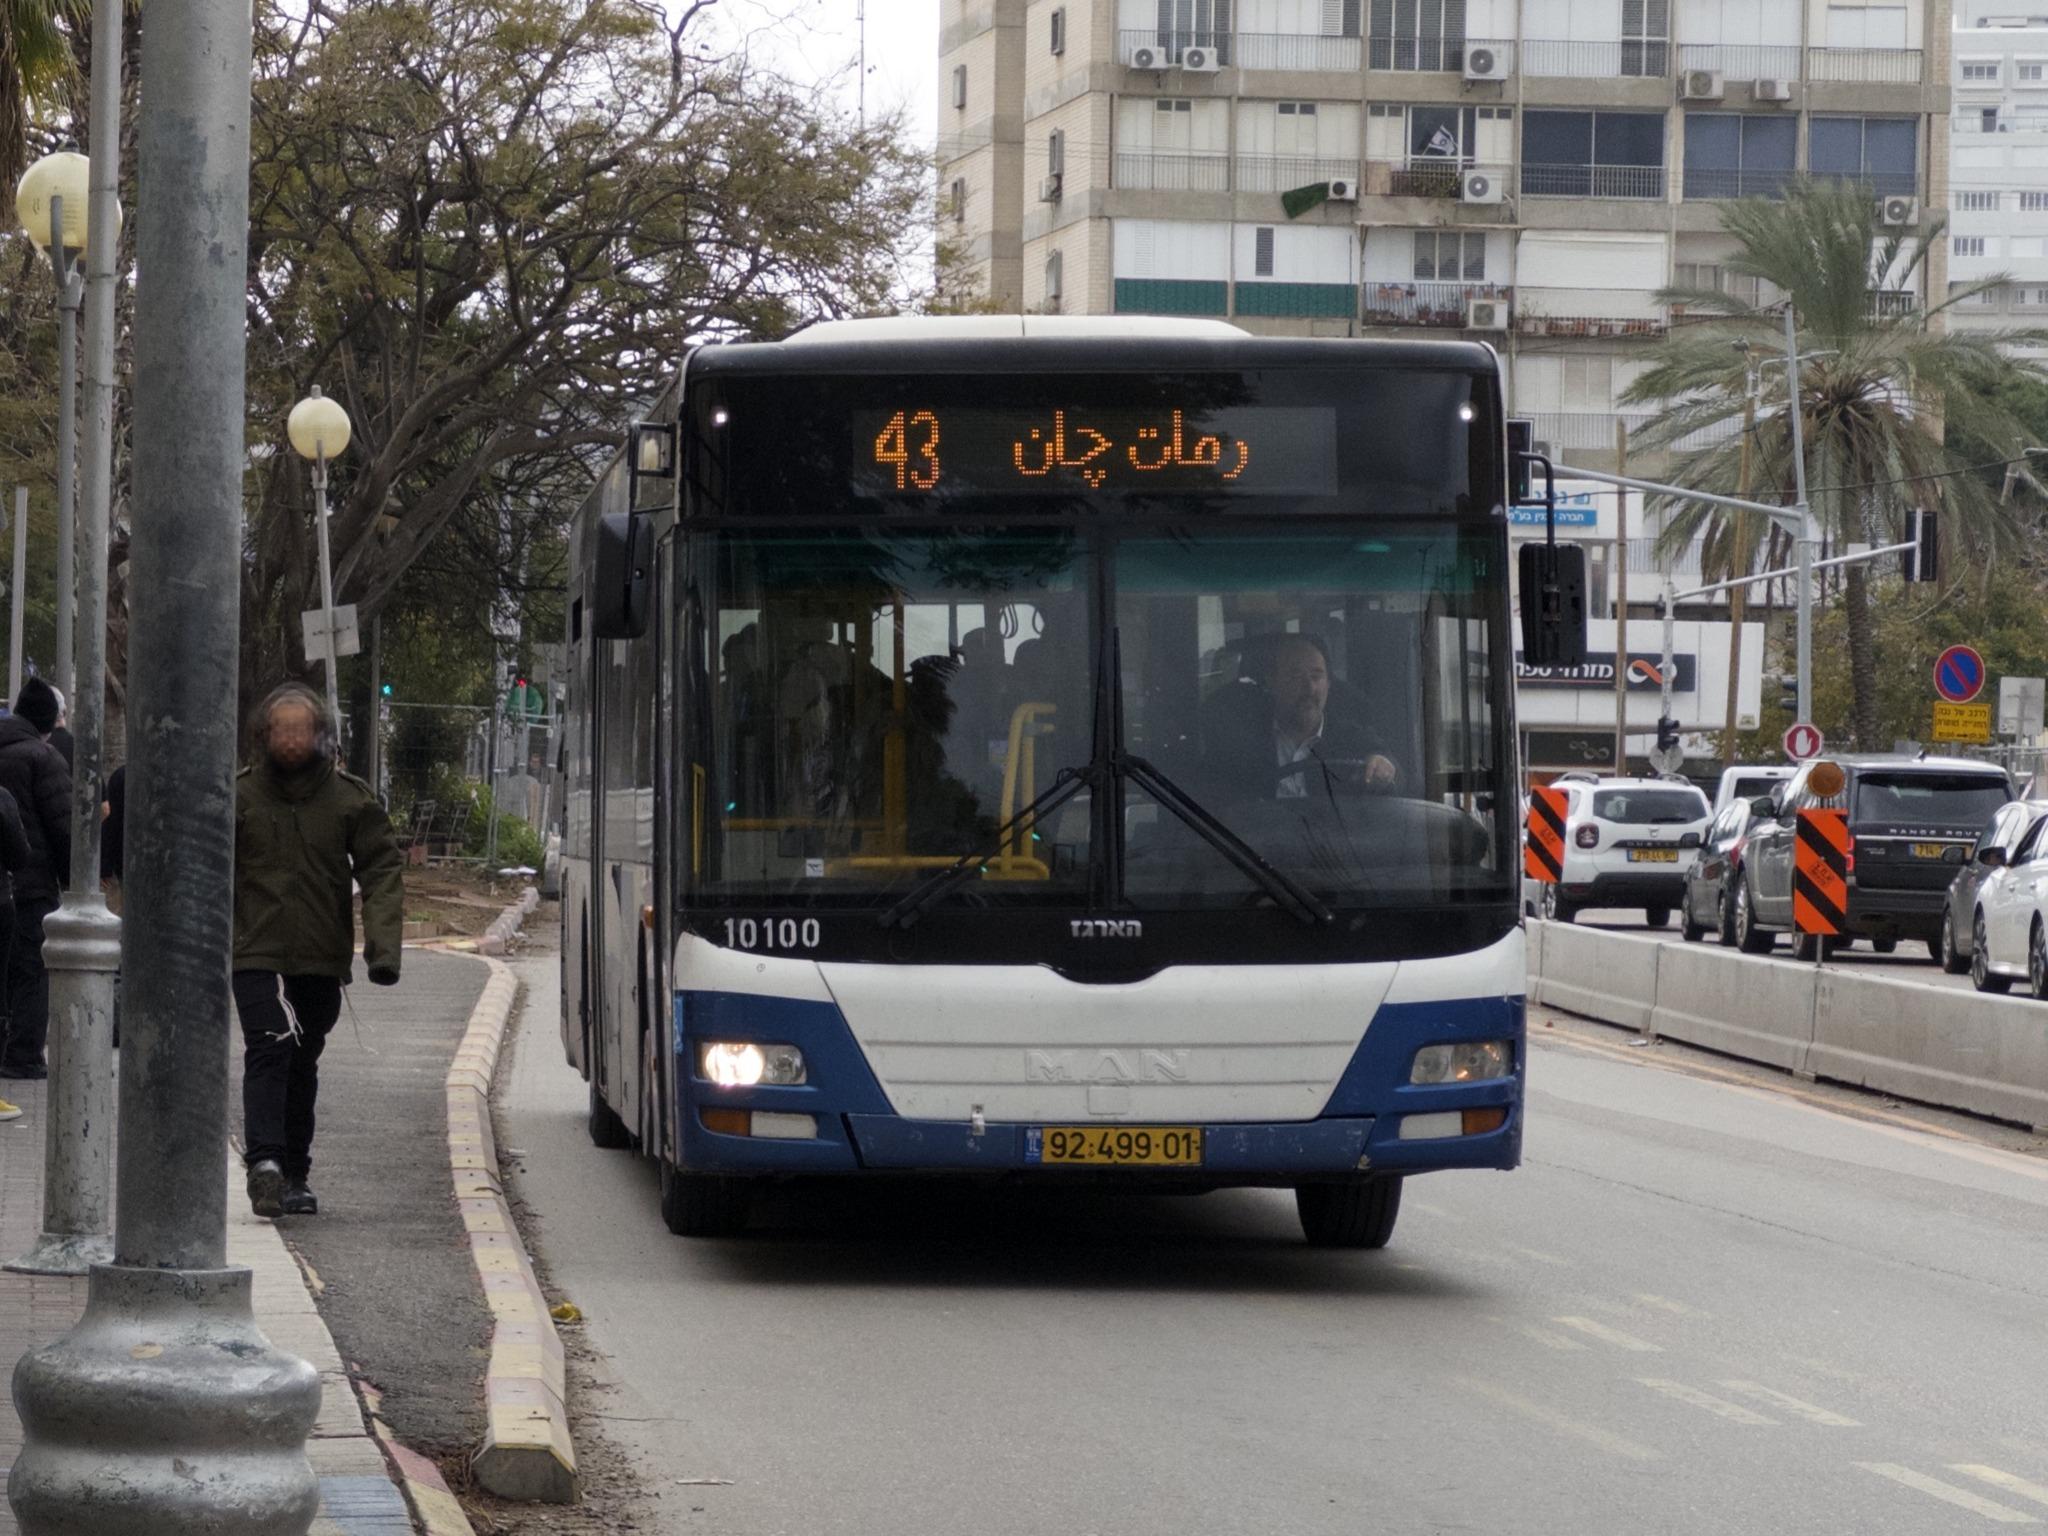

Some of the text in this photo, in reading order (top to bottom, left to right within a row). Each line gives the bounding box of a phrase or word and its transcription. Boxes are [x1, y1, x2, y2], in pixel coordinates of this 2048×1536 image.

[875, 410, 940, 489] 43
[1013, 409, 1248, 488] رمات چان
[1889, 828, 1937, 836] RANGE
[723, 917, 821, 949] 10100
[1070, 919, 1143, 938] הארגז
[1025, 1048, 1190, 1084] MAN
